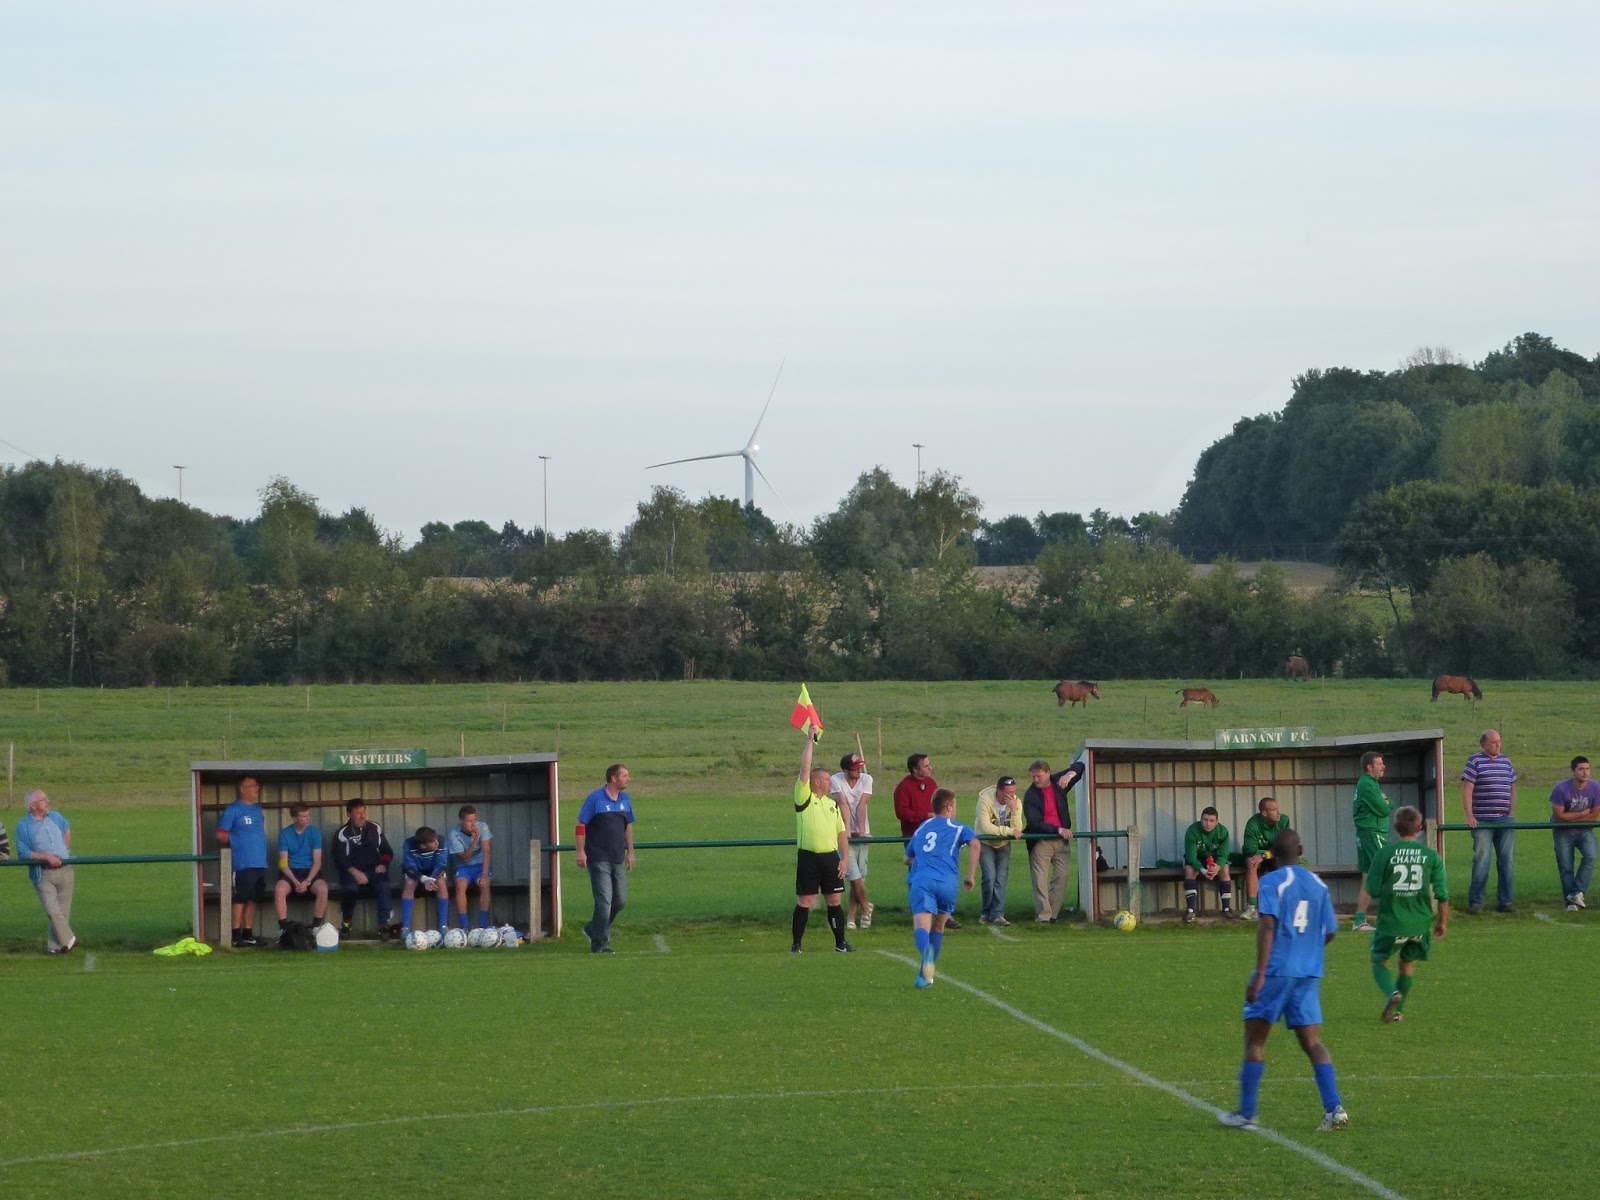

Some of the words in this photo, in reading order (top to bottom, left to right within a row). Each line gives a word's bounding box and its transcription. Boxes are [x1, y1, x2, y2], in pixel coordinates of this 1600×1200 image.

[1221, 732, 1282, 744] WARNANT
[1290, 731, 1310, 742] F.C.
[340, 753, 412, 765] VISITEURS
[922, 831, 938, 853] 3
[1395, 848, 1421, 856] LITERIE
[1390, 855, 1428, 865] CHANET
[1392, 864, 1423, 891] 23
[1293, 900, 1309, 933] 4
